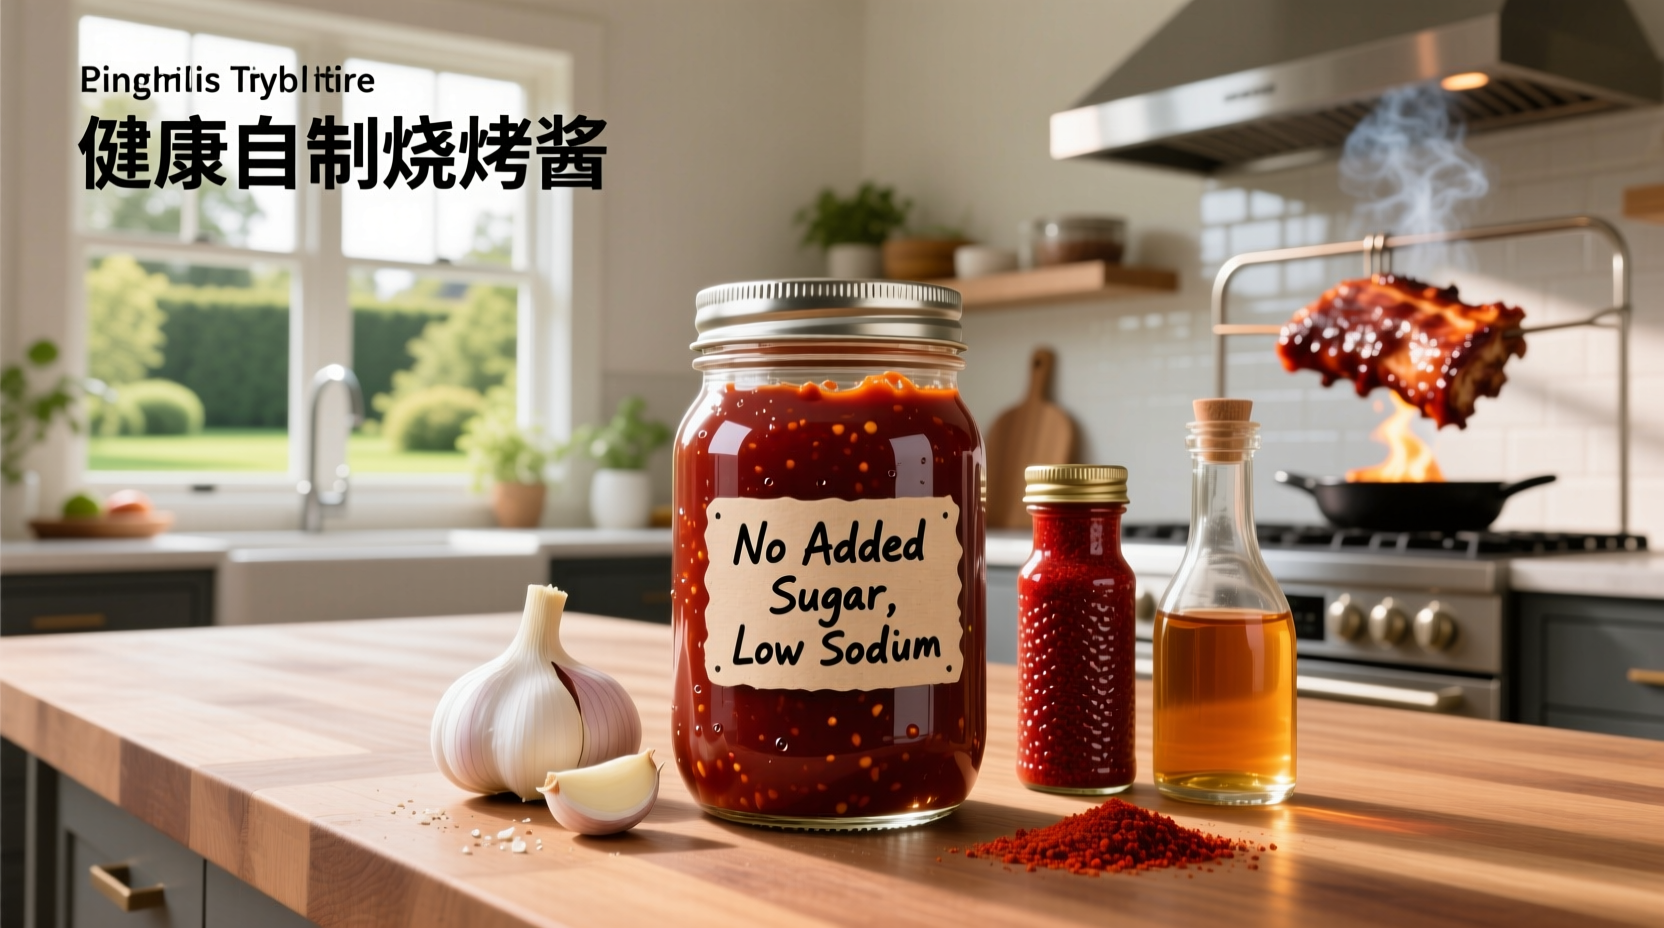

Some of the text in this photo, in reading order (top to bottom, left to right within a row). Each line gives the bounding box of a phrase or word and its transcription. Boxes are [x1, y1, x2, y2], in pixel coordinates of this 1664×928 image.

[733, 517, 927, 567] No Added
[769, 575, 897, 629] Sugar,
[732, 624, 942, 667] Low Sodium
